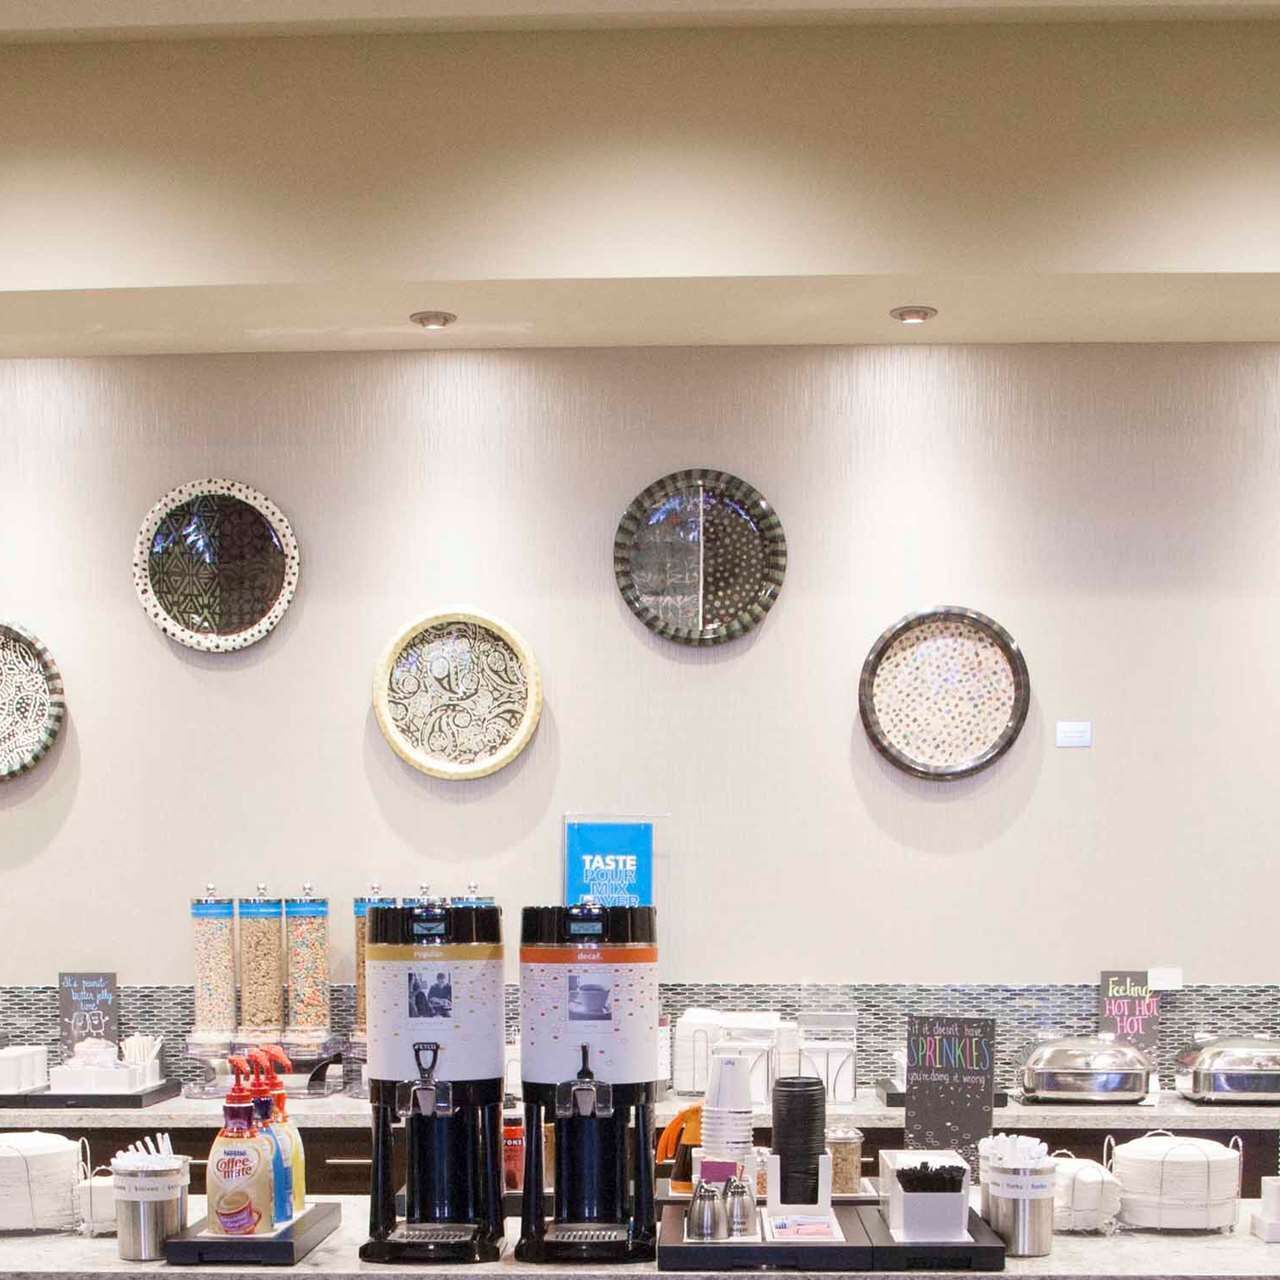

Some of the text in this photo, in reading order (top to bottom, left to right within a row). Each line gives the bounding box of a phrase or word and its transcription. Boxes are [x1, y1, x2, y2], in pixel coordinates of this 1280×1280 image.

[582, 855, 637, 870] TASTE
[584, 869, 637, 884] POUR
[590, 881, 630, 896] MIX
[1108, 976, 1153, 1004] Feeling
[1104, 997, 1160, 1017] HOT HOT
[1115, 1015, 1148, 1034] HOT
[907, 1034, 990, 1071] SPRINKLES
[223, 1165, 252, 1179] mate
